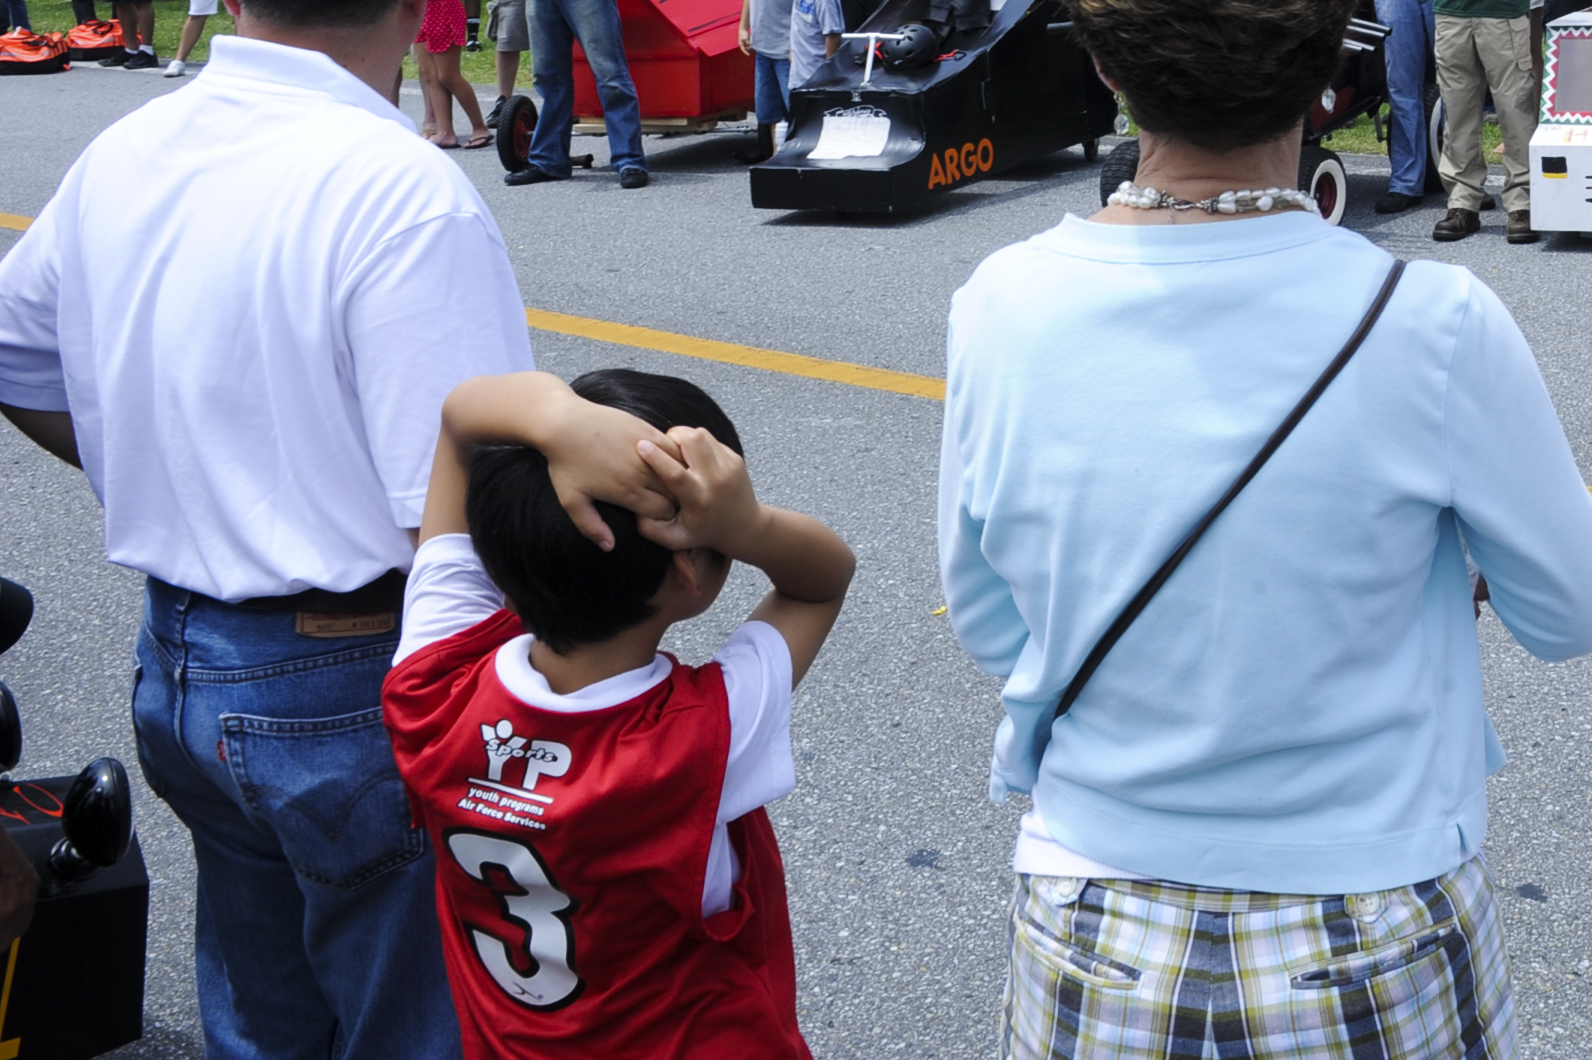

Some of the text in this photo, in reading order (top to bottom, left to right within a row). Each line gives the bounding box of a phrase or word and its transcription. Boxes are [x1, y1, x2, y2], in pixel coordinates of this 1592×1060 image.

[928, 137, 994, 190] ARGO
[457, 798, 547, 831] Air Force Services
[468, 787, 545, 817] youth programs
[443, 826, 587, 1014] 3
